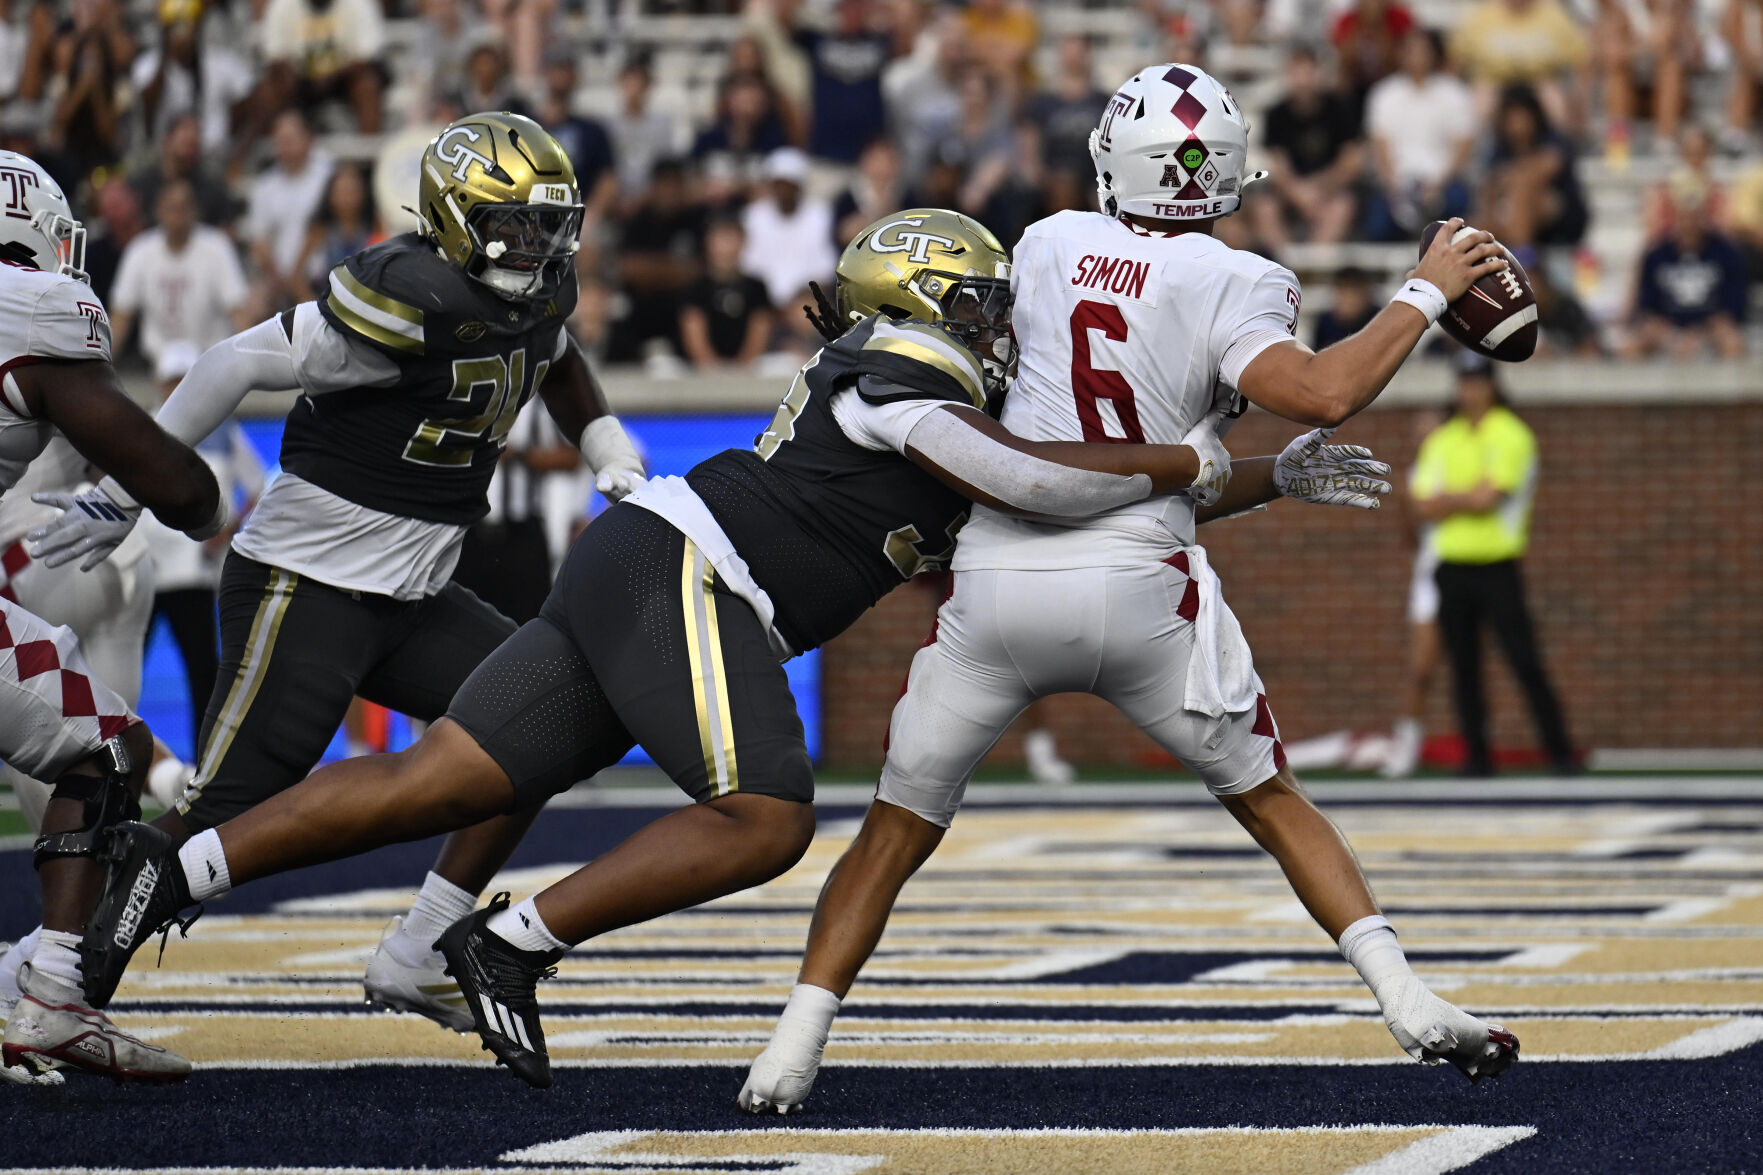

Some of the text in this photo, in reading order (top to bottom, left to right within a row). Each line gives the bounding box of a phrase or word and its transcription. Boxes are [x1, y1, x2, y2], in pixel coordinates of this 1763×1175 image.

[434, 126, 497, 184] GT
[1184, 153, 1201, 163] C2P
[1204, 170, 1213, 182] 6
[545, 186, 566, 203] TECH
[1153, 201, 1222, 217] TEMPLE
[869, 218, 954, 265] GT
[1071, 254, 1150, 300] SIMON
[1069, 298, 1147, 444] 6
